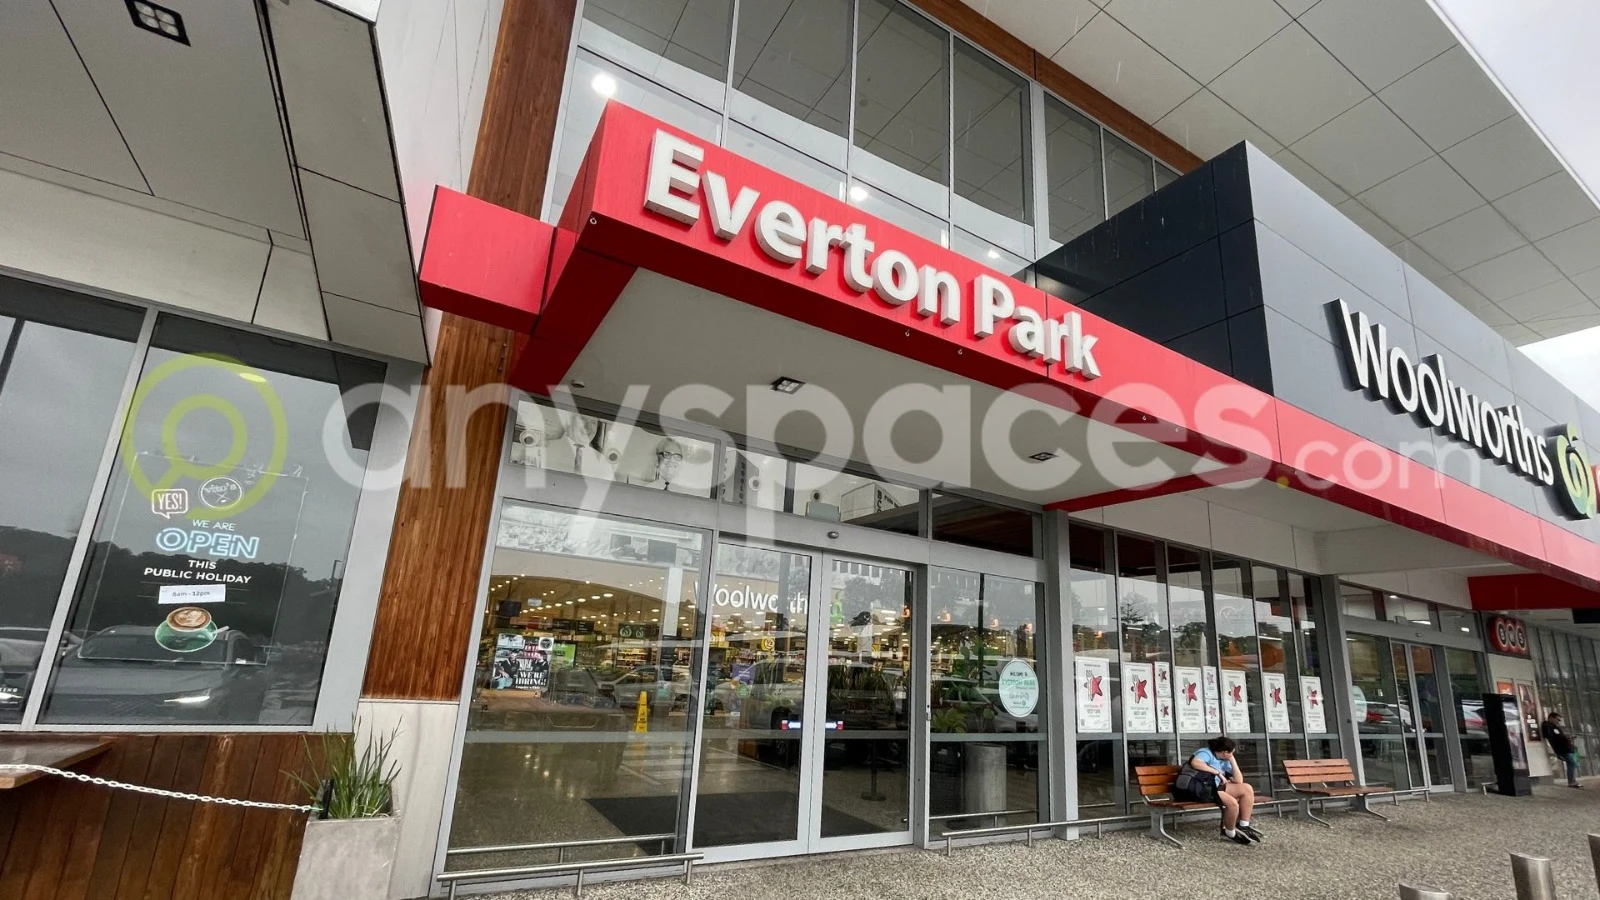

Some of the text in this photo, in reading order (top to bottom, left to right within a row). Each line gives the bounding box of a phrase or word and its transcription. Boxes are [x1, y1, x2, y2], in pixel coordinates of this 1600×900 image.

[644, 128, 1102, 380] Everton Park
[1330, 298, 1554, 486] Woolworths
[157, 492, 183, 510] YES!
[192, 519, 236, 531] WE ARE
[156, 527, 260, 559] OPEN
[188, 559, 217, 570] THIS
[144, 567, 252, 584] PUBLIC HOLIDAY
[515, 678, 547, 686] HIRING!
[520, 671, 545, 679] WE'RE
